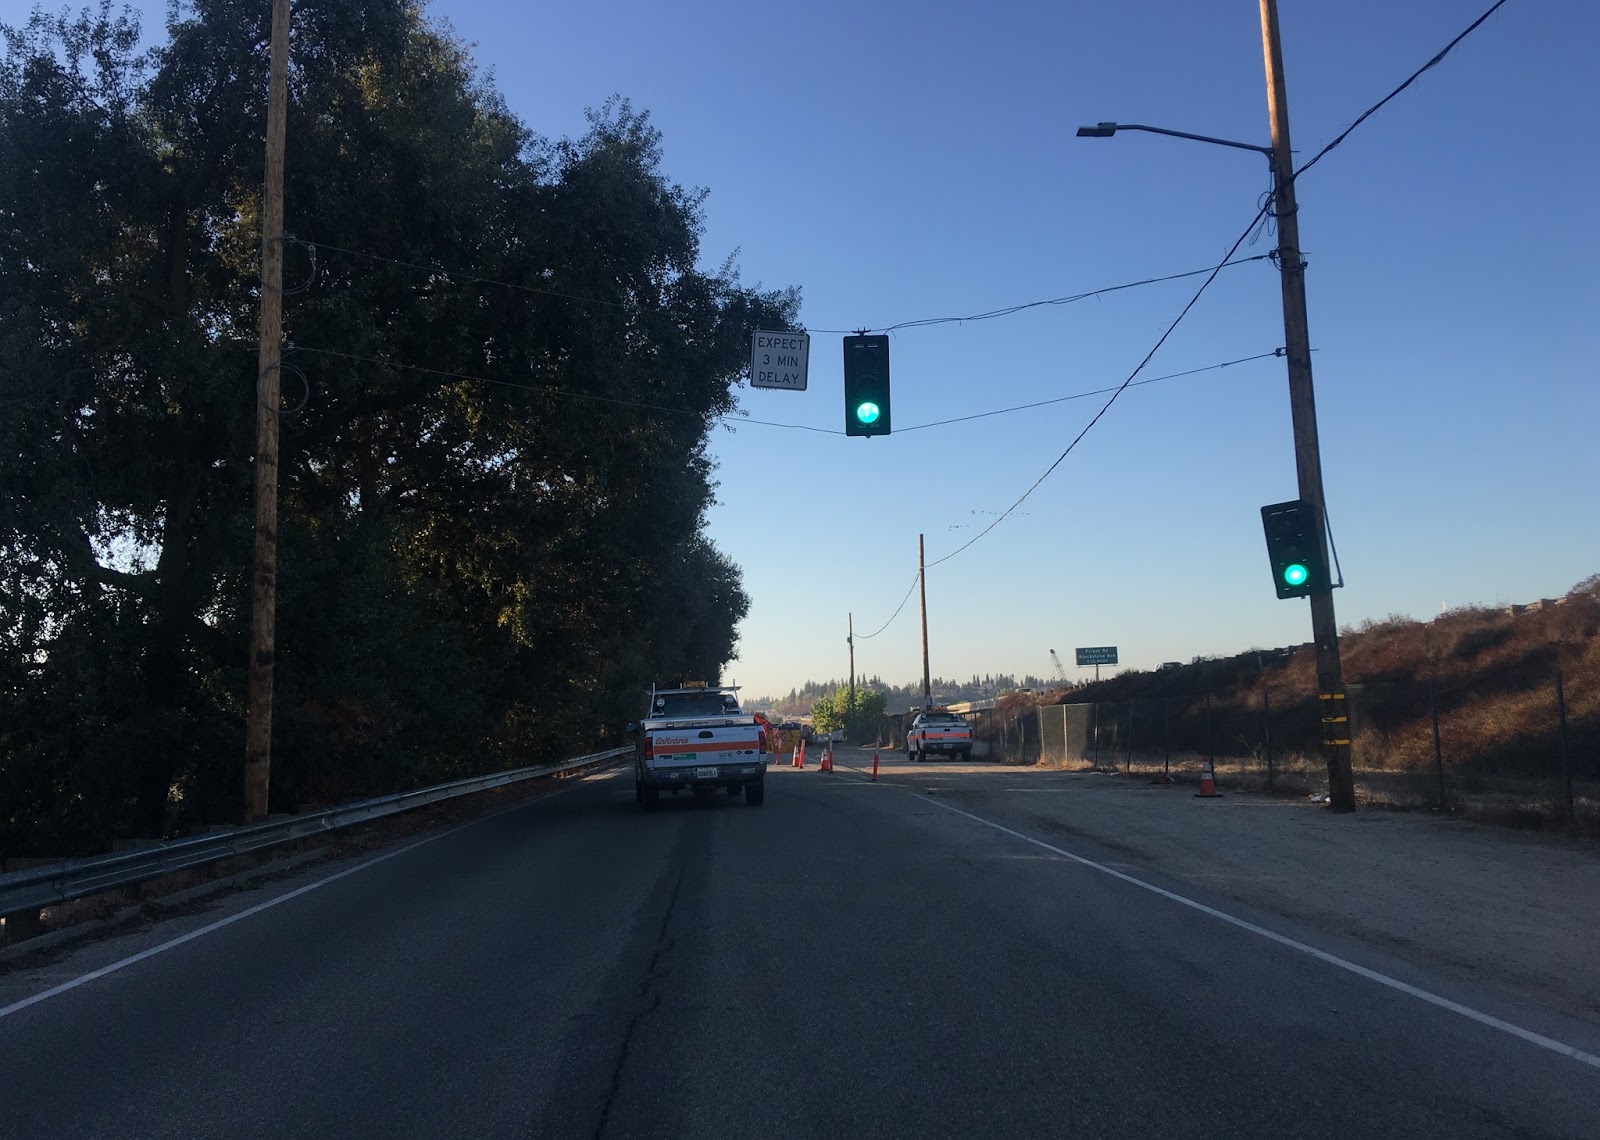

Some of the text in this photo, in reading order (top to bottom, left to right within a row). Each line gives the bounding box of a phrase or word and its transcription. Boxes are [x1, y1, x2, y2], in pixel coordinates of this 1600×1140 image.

[758, 337, 804, 350] EXPECT
[763, 354, 798, 367] 3 MIN
[758, 371, 799, 384] DELAY
[655, 737, 689, 745] Caltrans
